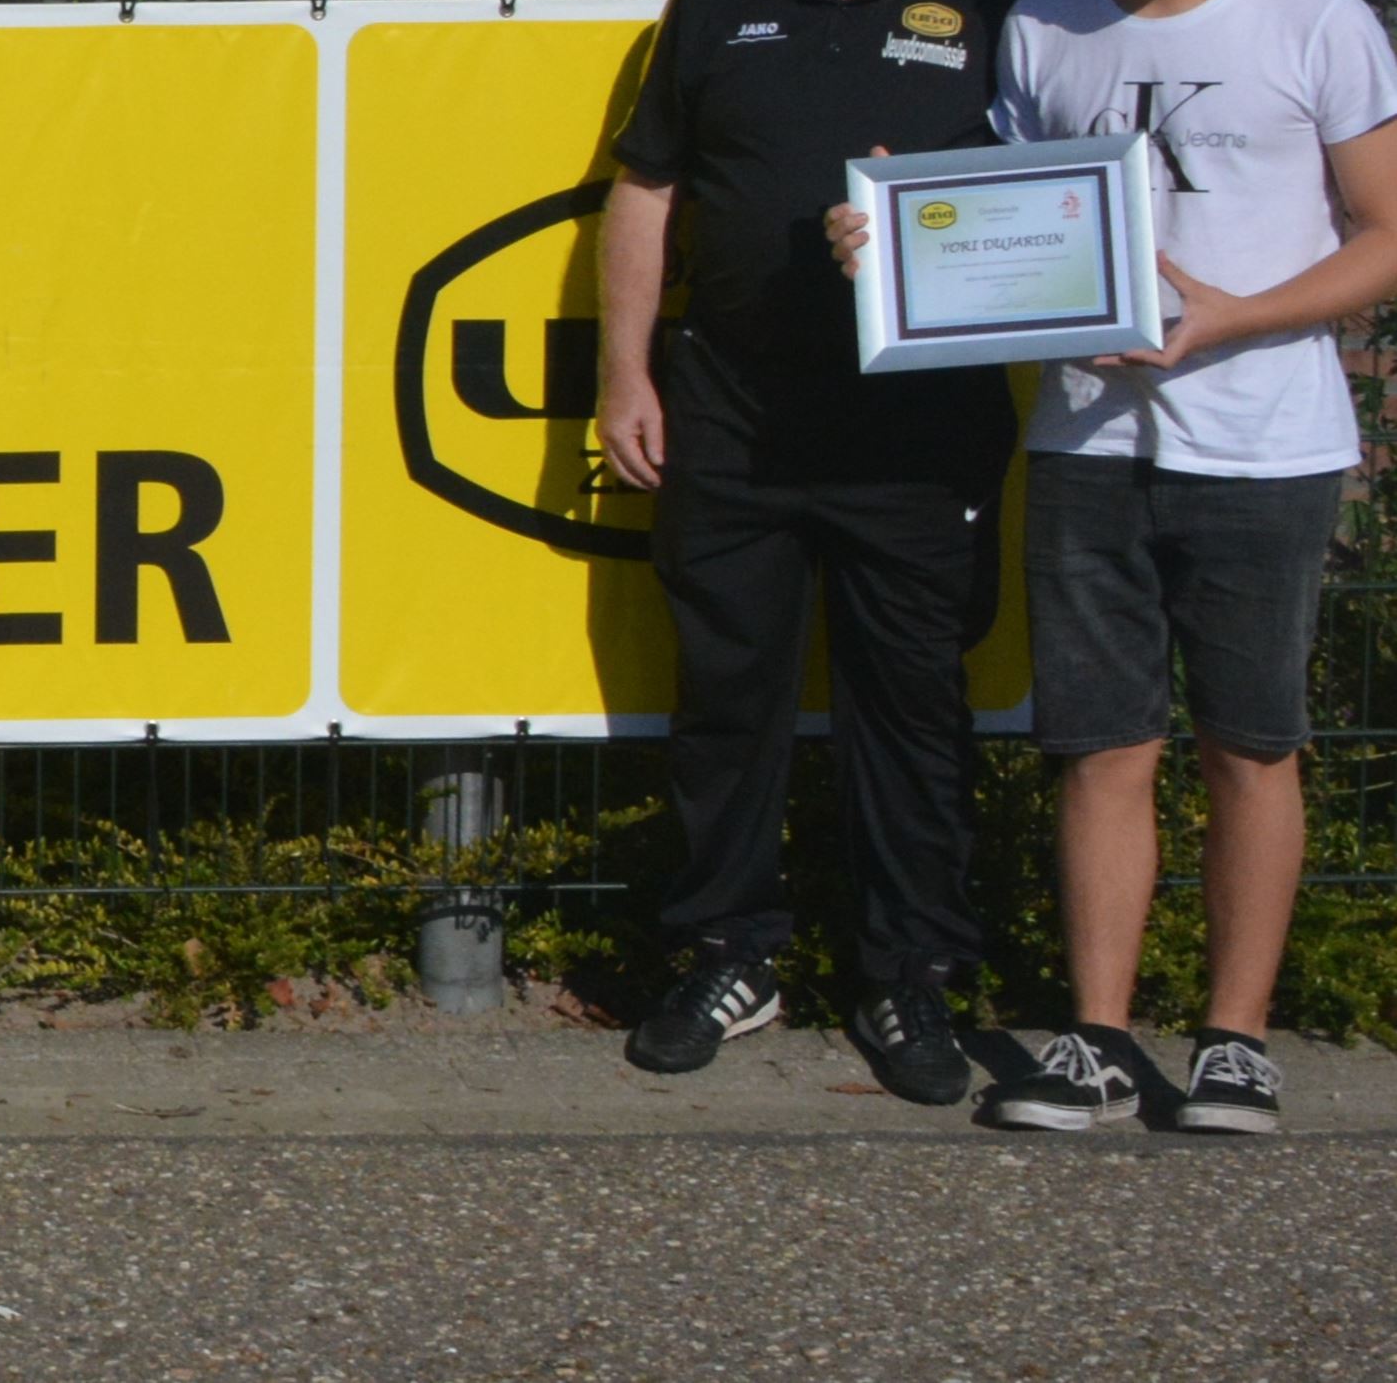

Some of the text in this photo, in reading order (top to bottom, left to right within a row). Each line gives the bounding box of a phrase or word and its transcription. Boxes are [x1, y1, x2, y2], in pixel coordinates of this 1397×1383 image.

[737, 22, 779, 36] JAKO
[882, 31, 966, 70] Jeugdcommissie
[1179, 128, 1247, 148] Jeans
[940, 232, 1065, 254] YORI DUJARDIN
